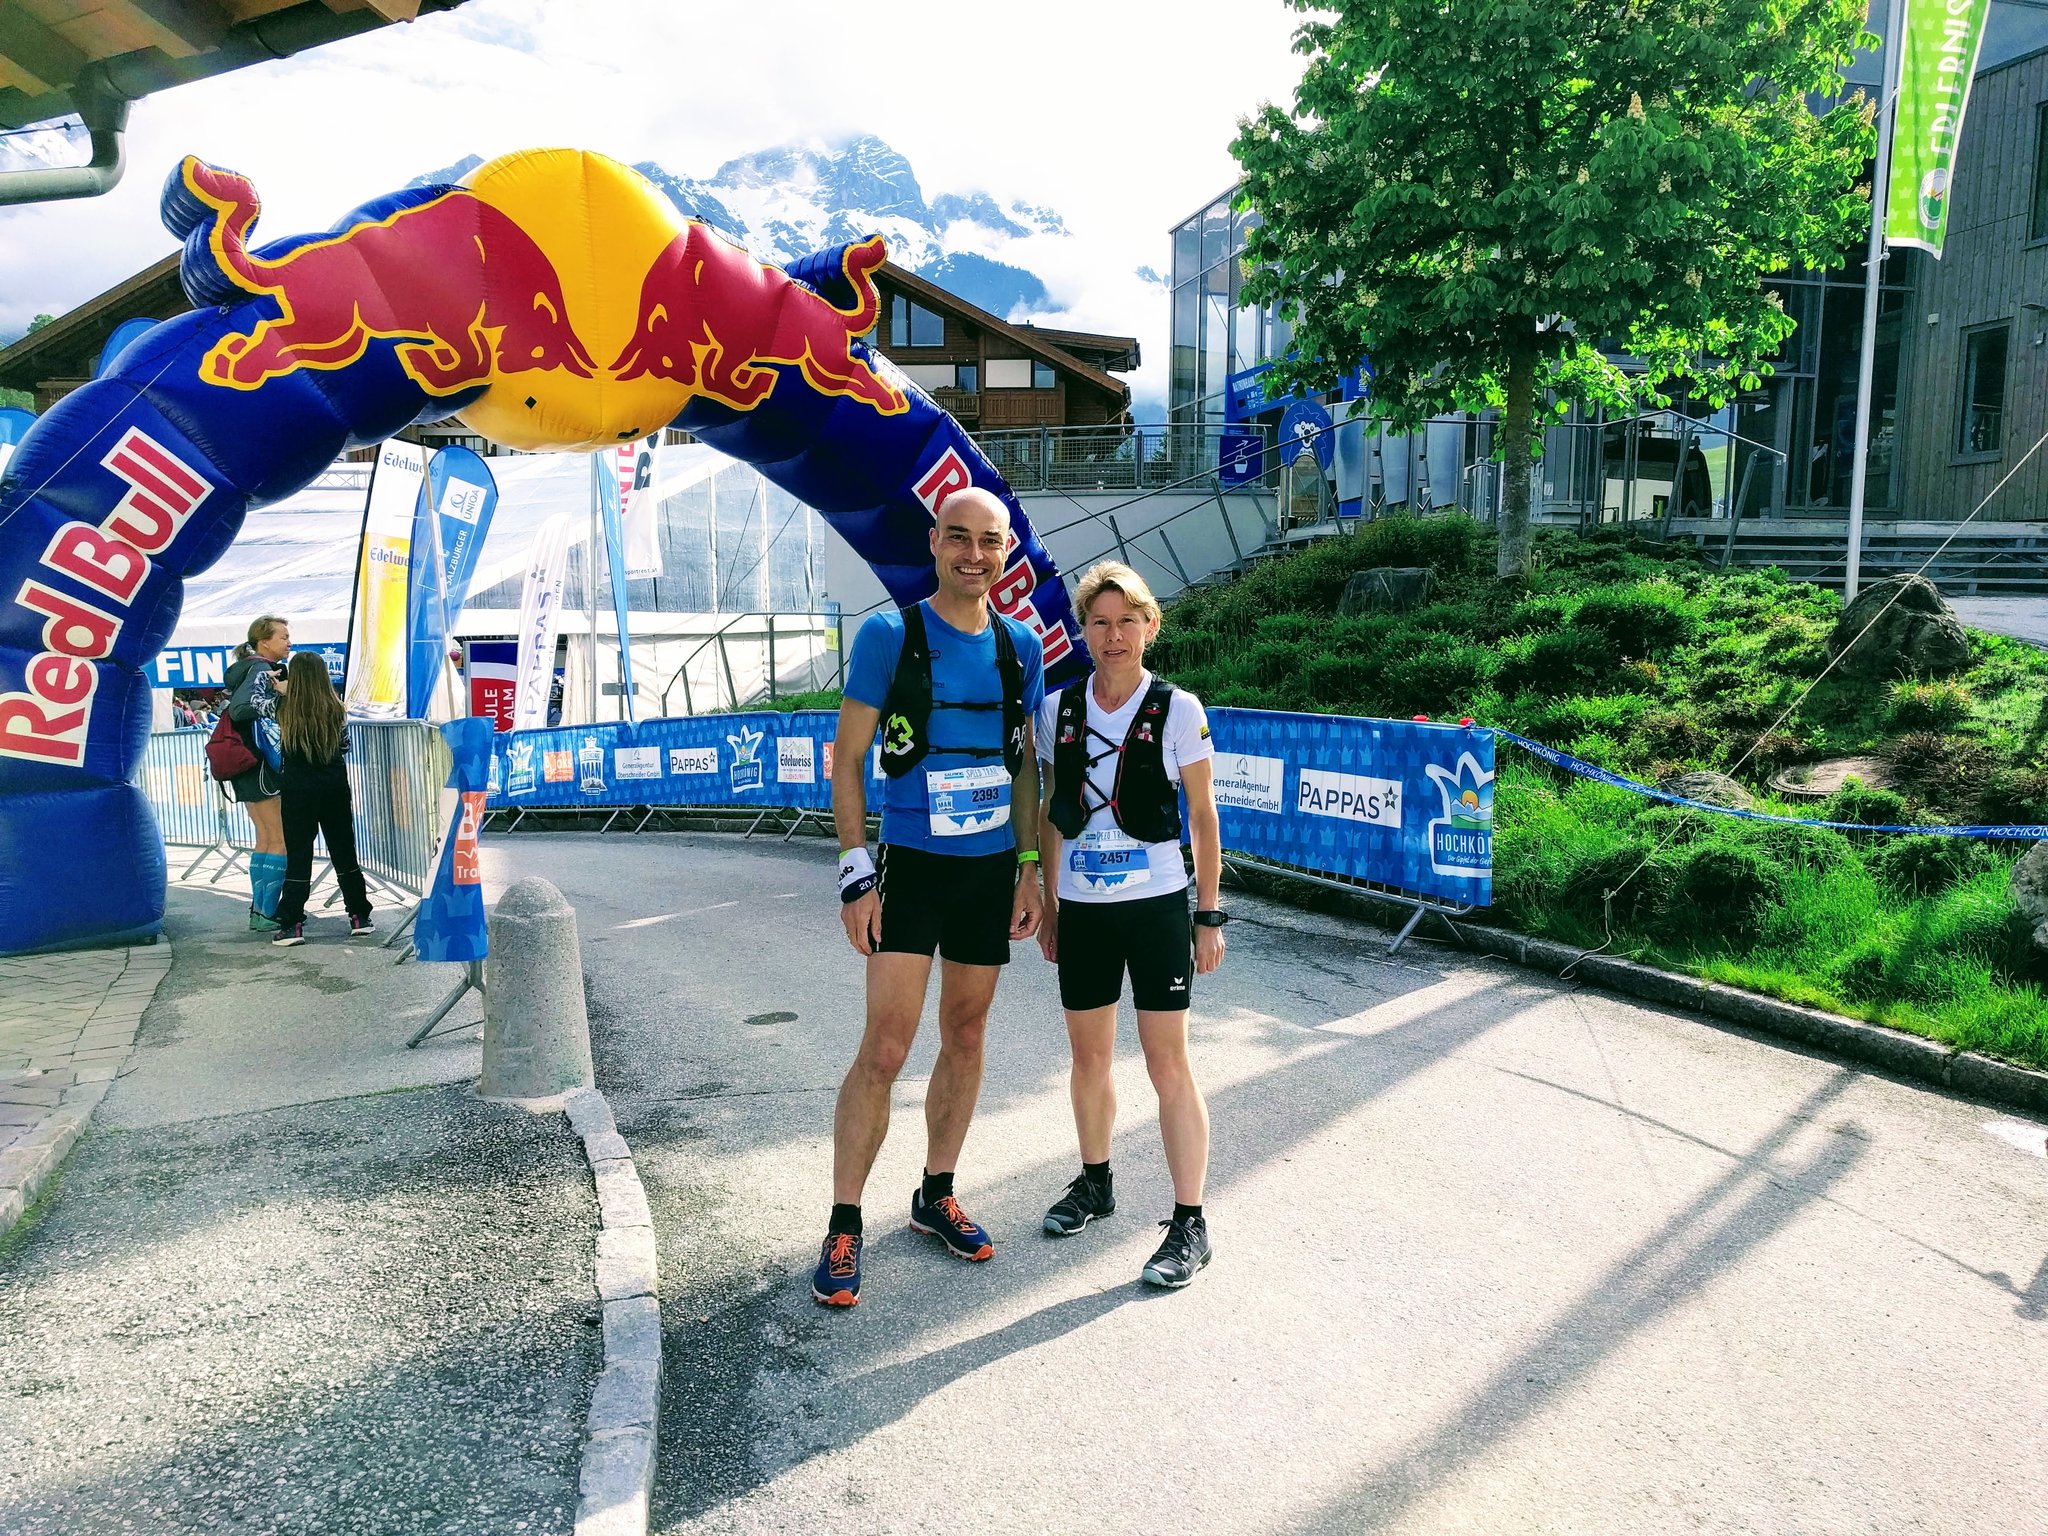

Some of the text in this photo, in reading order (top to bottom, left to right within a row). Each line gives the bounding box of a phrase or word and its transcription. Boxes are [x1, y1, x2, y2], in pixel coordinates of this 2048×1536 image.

[464, 489, 480, 520] UNIQA
[0, 428, 212, 765] Red Bull
[503, 688, 514, 723] ALM
[671, 756, 709, 772] PAPPAS
[781, 753, 812, 768] Edelweiss
[582, 761, 602, 781] MAN
[1570, 761, 1617, 783] HOCHKÖNIG
[972, 787, 999, 803] 2393
[1213, 778, 1270, 794] eneralAgentur
[1215, 793, 1279, 811] schneider GmbH
[1299, 781, 1380, 819] PAPPAS
[1099, 851, 1131, 865] 2457
